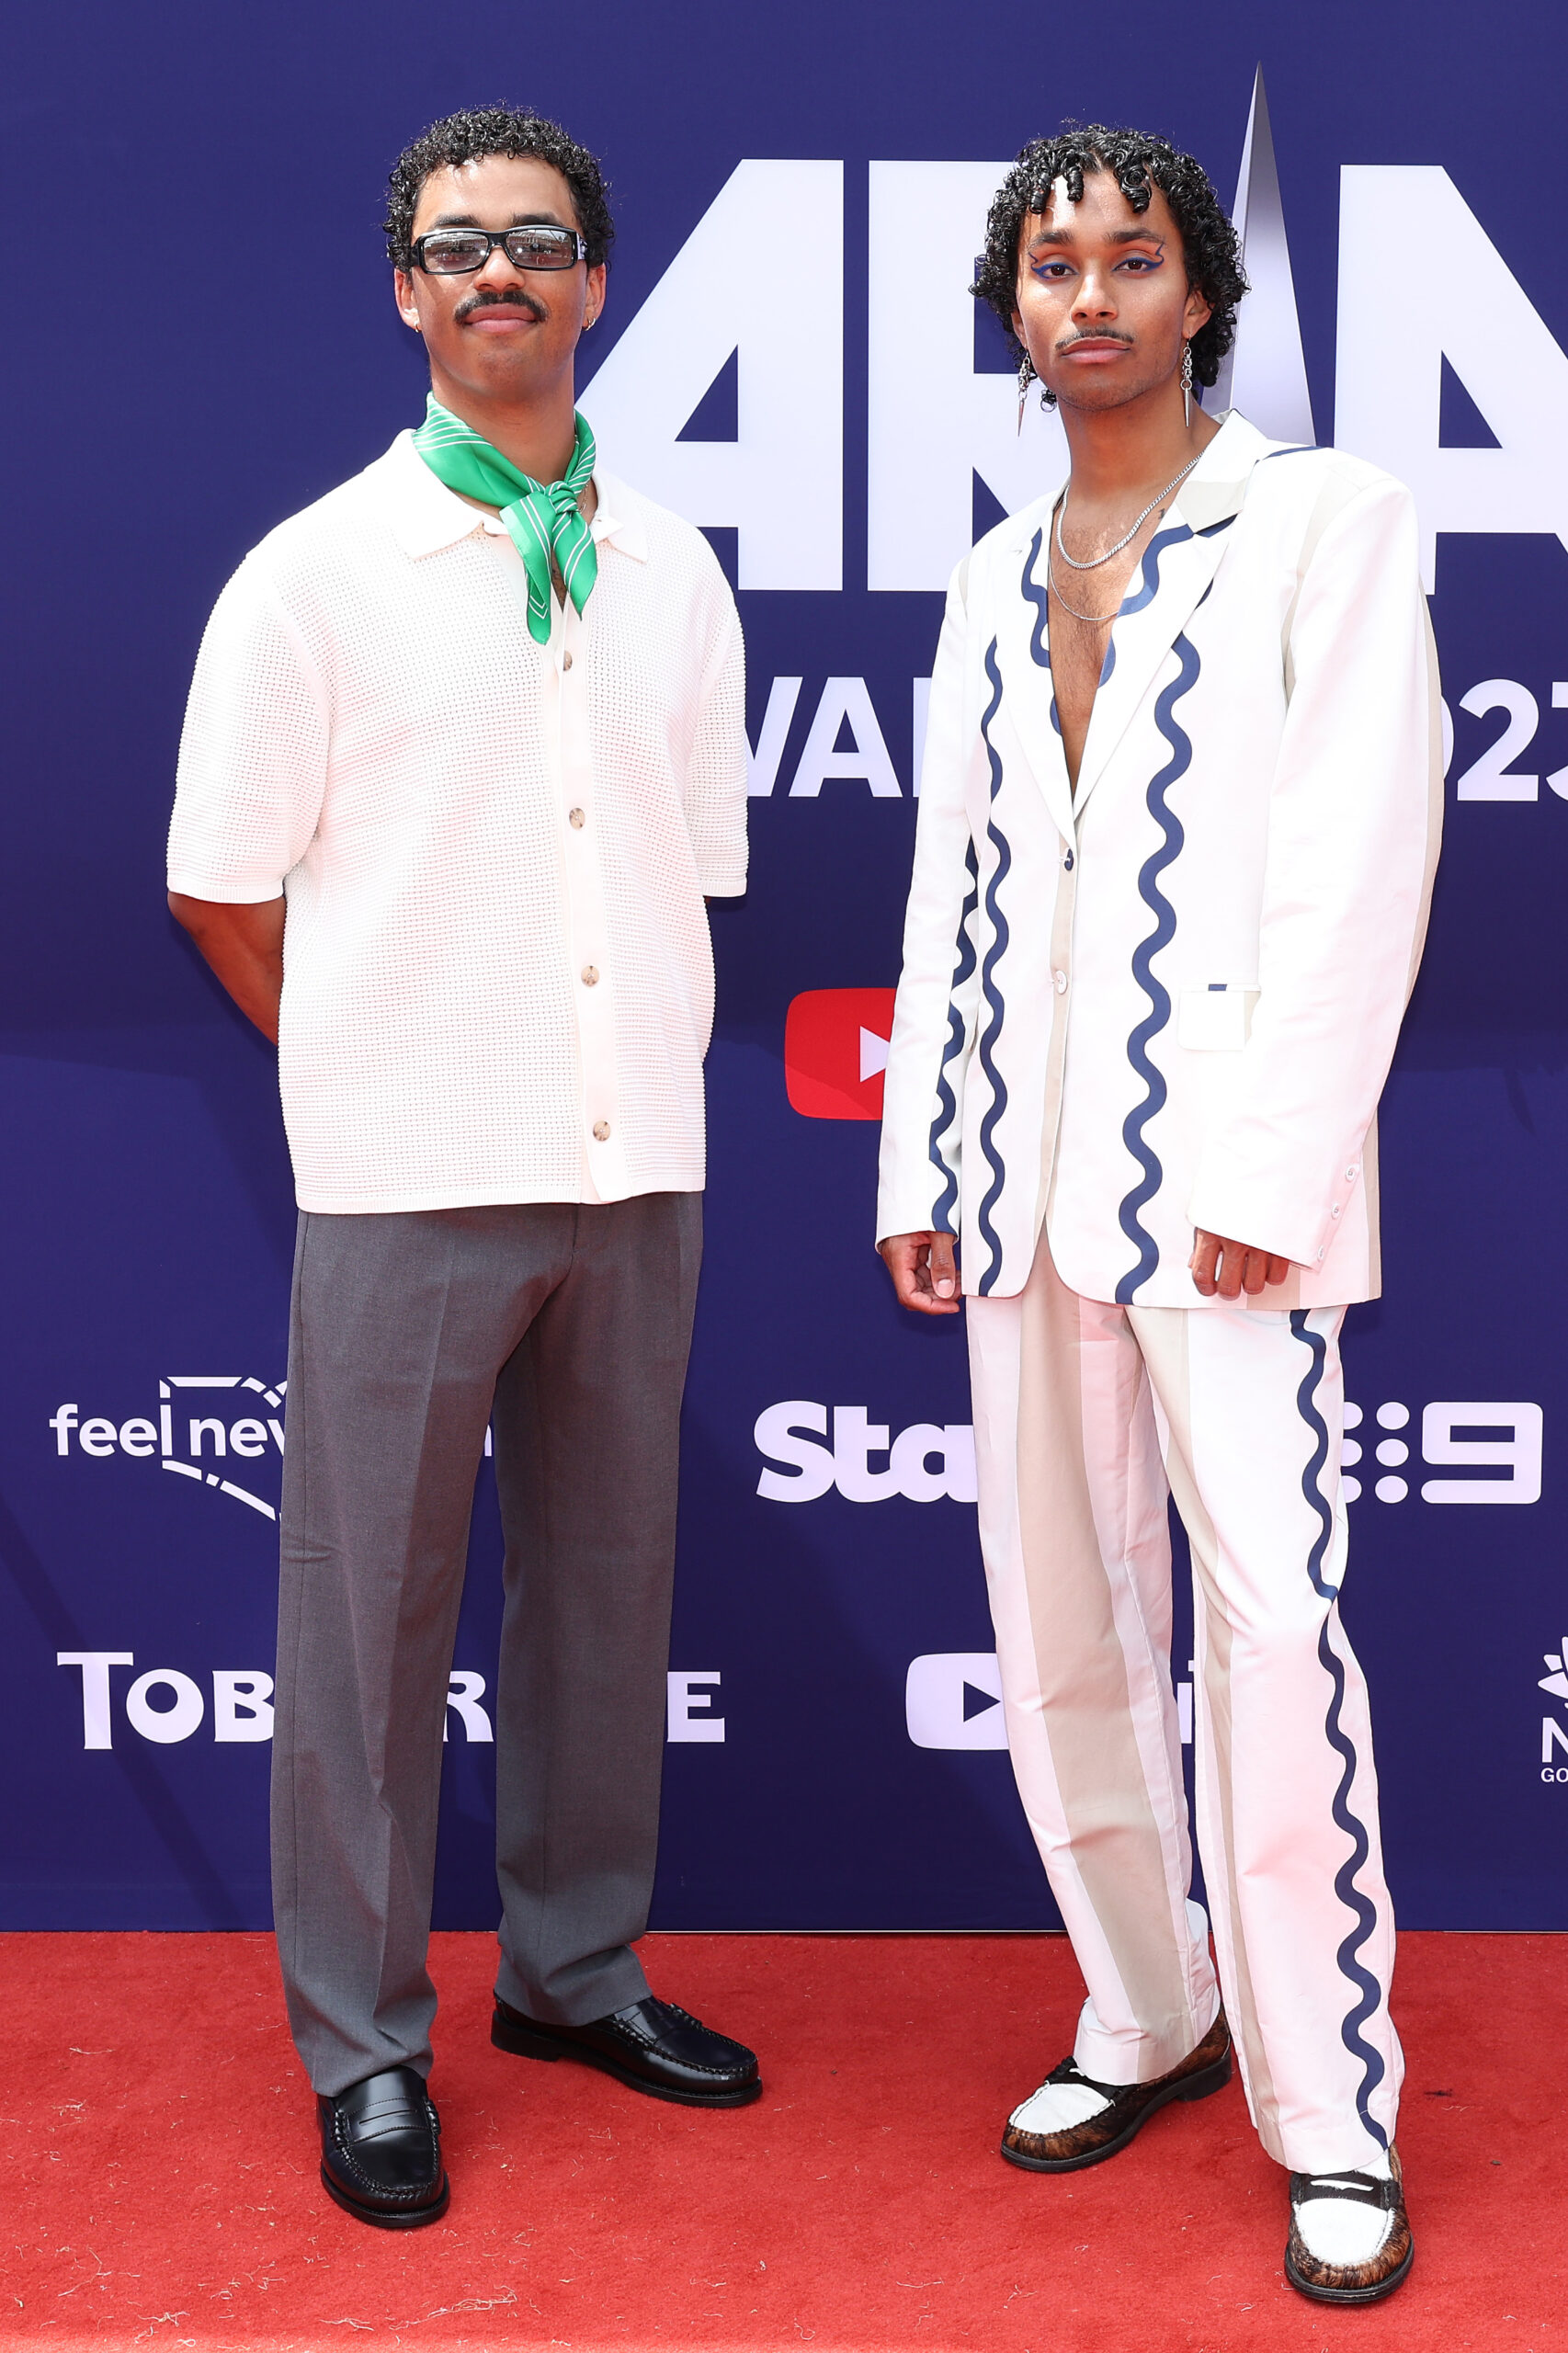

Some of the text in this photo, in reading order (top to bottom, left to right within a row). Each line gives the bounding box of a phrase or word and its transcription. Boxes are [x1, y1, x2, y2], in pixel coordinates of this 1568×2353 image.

[49, 1403, 173, 1457] feel
[754, 1401, 978, 1503] Sta
[57, 1652, 725, 1750] TOBRE
